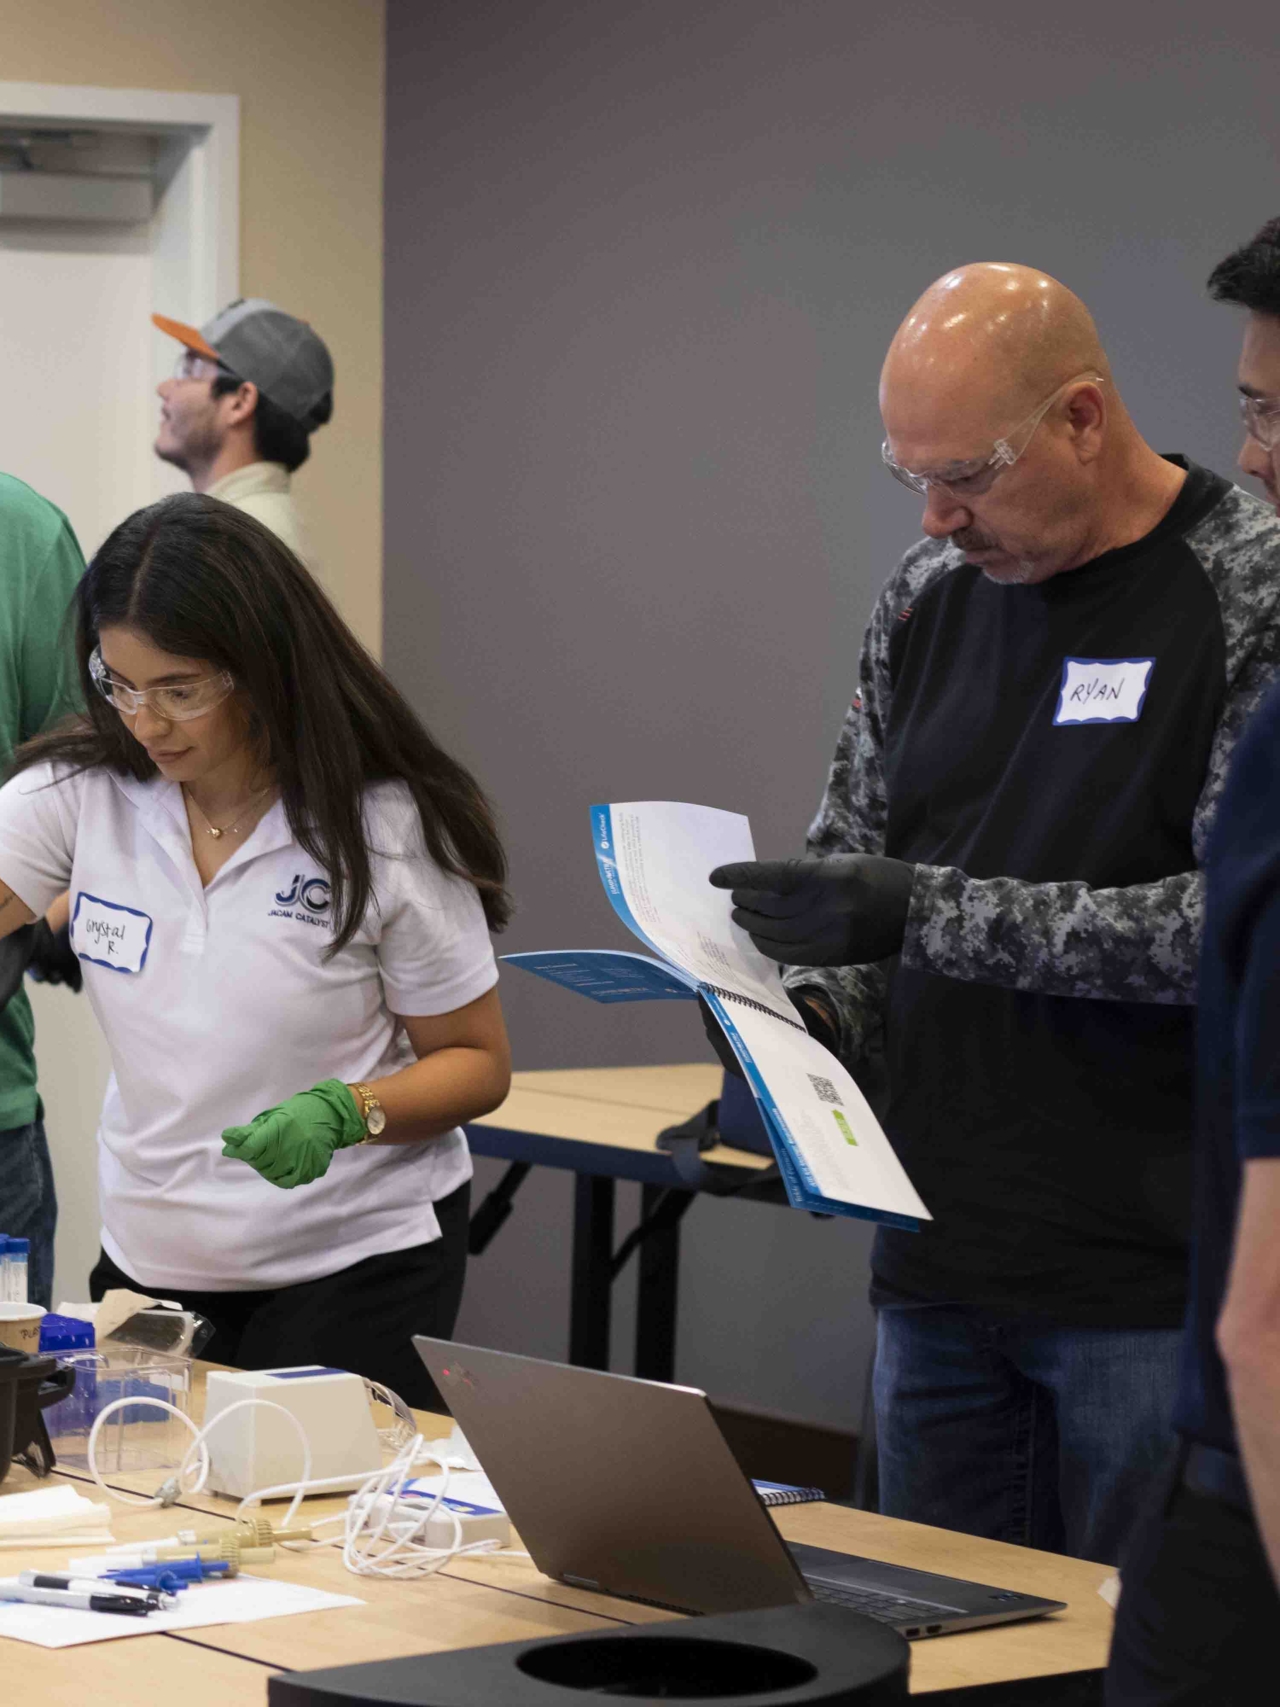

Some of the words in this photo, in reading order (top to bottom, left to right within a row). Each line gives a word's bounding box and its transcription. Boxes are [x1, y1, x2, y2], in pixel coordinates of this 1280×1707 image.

[1069, 677, 1125, 705] RYAN
[275, 874, 332, 914] JC
[268, 909, 294, 918] JACAM
[86, 919, 126, 945] Crystal
